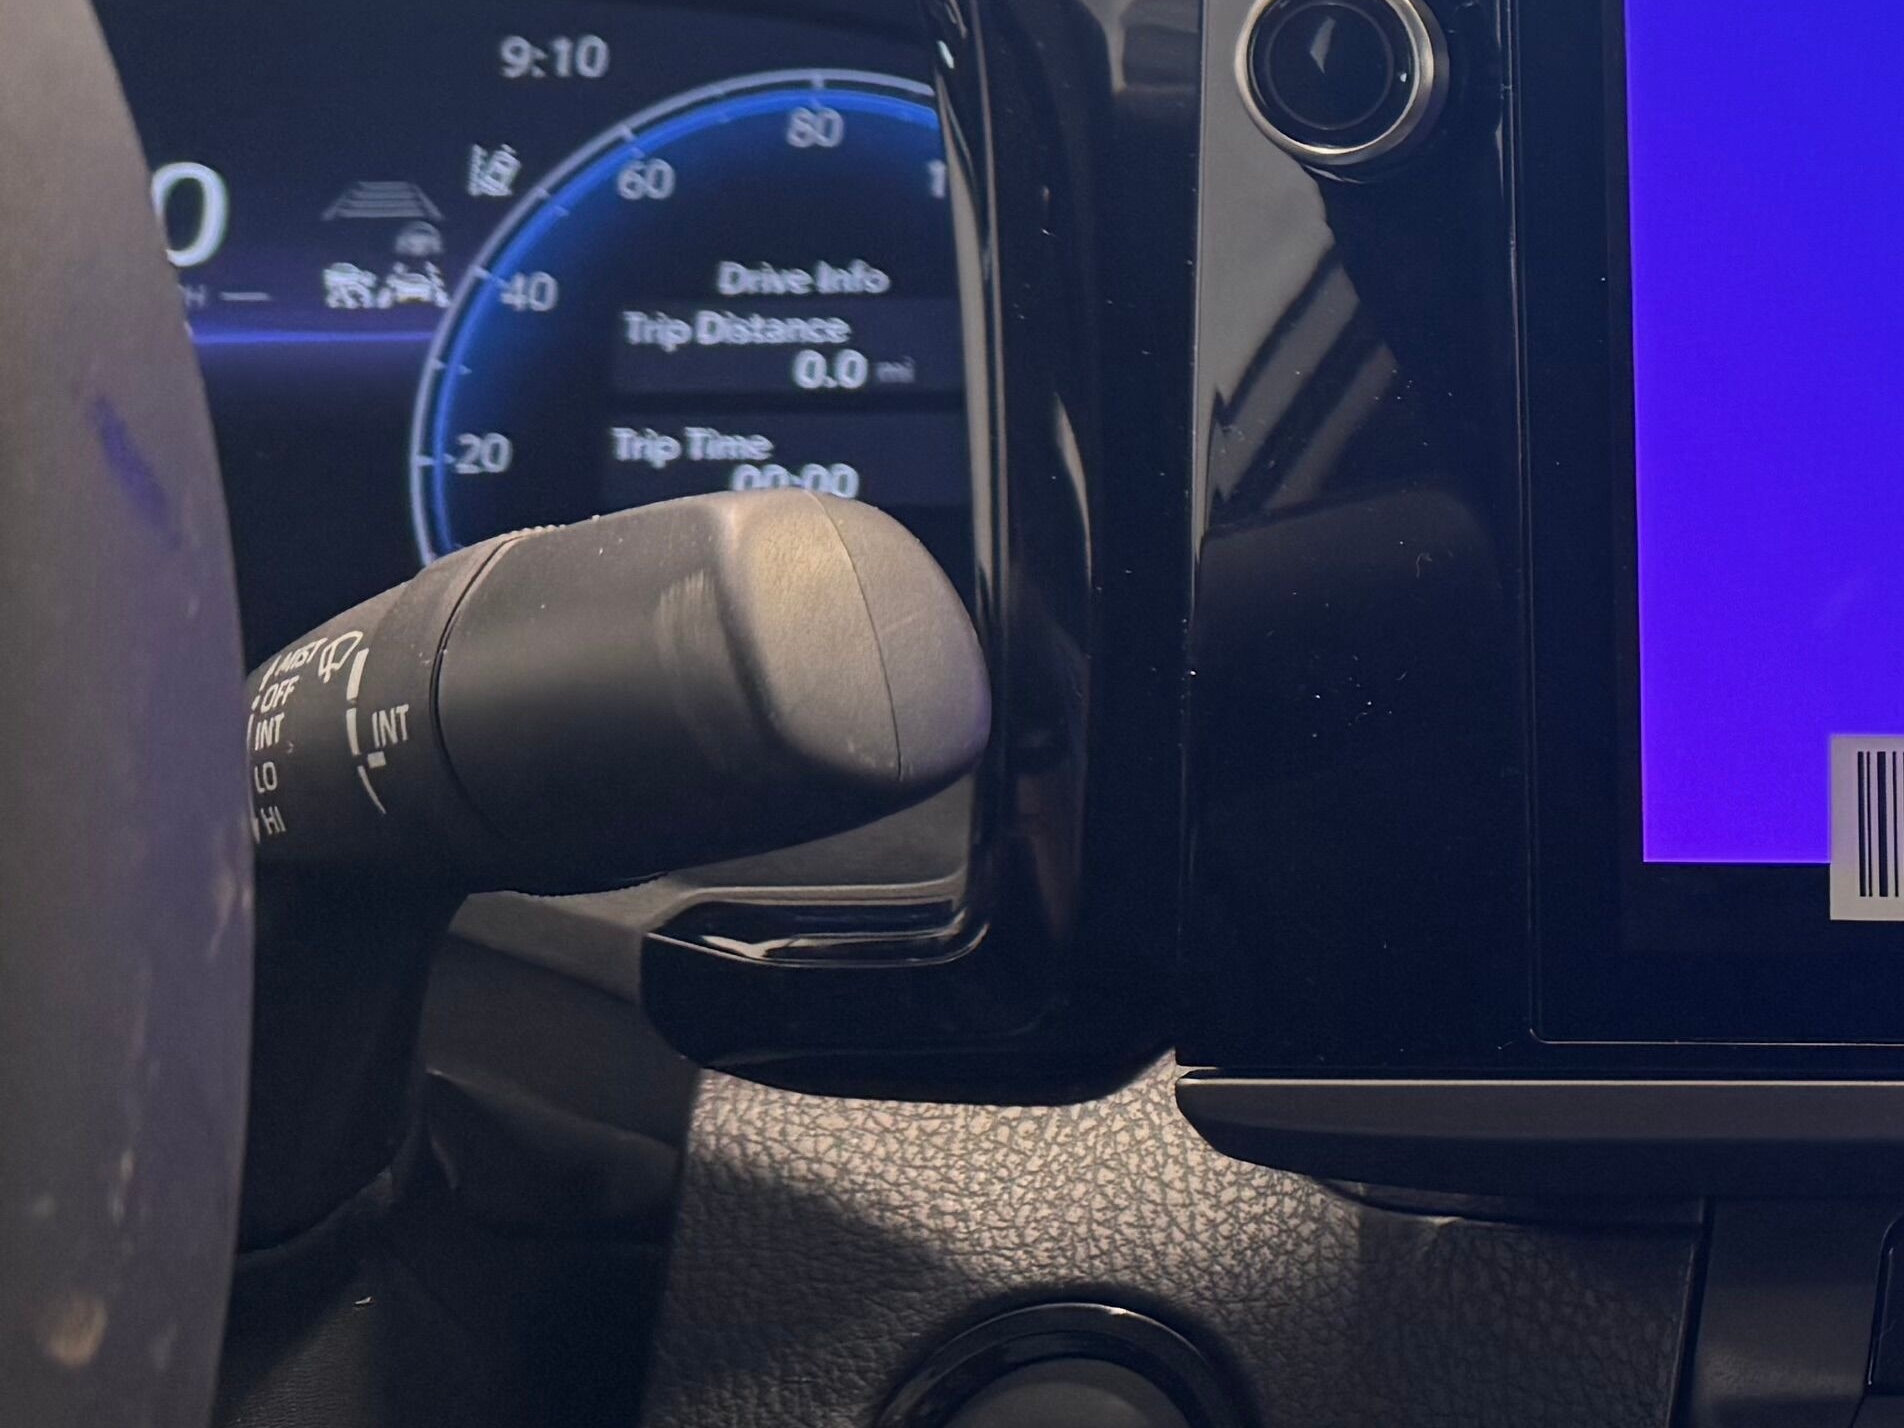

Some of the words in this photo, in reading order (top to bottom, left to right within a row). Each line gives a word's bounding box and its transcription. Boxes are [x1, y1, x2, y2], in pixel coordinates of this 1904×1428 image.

[500, 35, 609, 78] 9:10
[786, 106, 844, 149] 80
[617, 158, 675, 201] 60
[500, 271, 559, 312] 40
[717, 261, 812, 295] Drive
[815, 260, 891, 294] Info
[623, 310, 692, 353] Trip
[695, 309, 851, 345] Distance
[793, 349, 868, 389] 0.0
[455, 433, 513, 474] 20
[610, 427, 682, 468] Trip
[685, 427, 773, 460] Time
[260, 675, 300, 713] OFF
[254, 712, 285, 752] INT
[372, 703, 410, 749] INT
[253, 761, 278, 794] LO
[260, 805, 287, 836] HI
